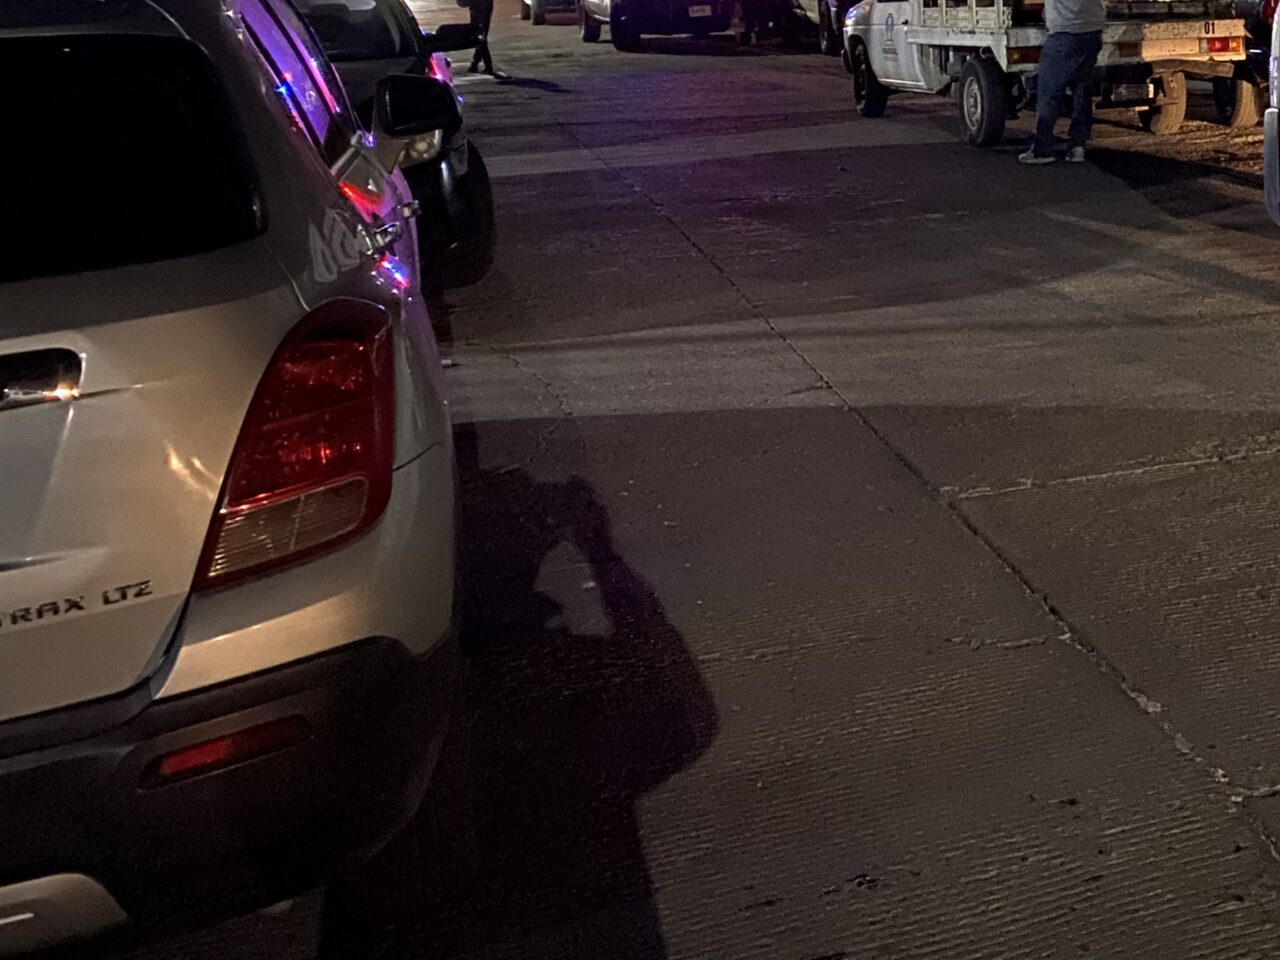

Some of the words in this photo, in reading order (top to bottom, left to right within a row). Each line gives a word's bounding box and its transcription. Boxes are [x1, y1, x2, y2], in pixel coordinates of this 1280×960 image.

[1204, 21, 1215, 34] 01
[0, 596, 85, 628] RAX
[102, 580, 152, 605] LTZ
